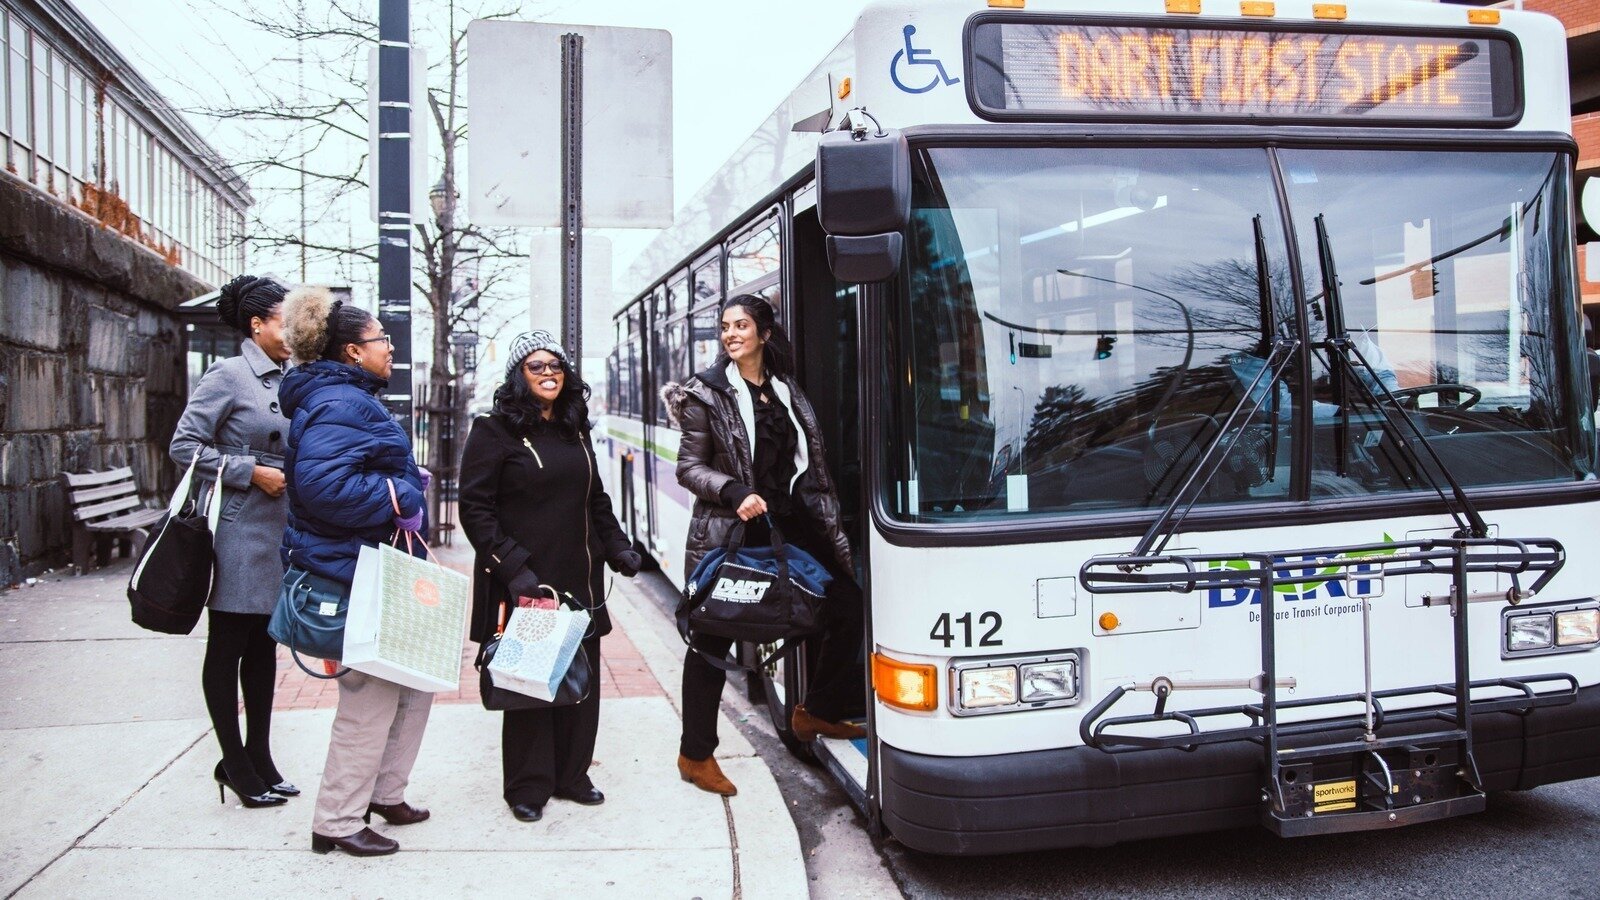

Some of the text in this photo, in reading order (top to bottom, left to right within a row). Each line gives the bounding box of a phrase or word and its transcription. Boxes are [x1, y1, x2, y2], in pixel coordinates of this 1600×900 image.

[1058, 33, 1460, 104] DART FIRST STATE
[711, 577, 771, 600] DART
[1292, 606, 1321, 619] Transit
[1323, 601, 1372, 617] Corporatin
[929, 610, 1003, 648] 412
[1315, 785, 1354, 797] sportworks
